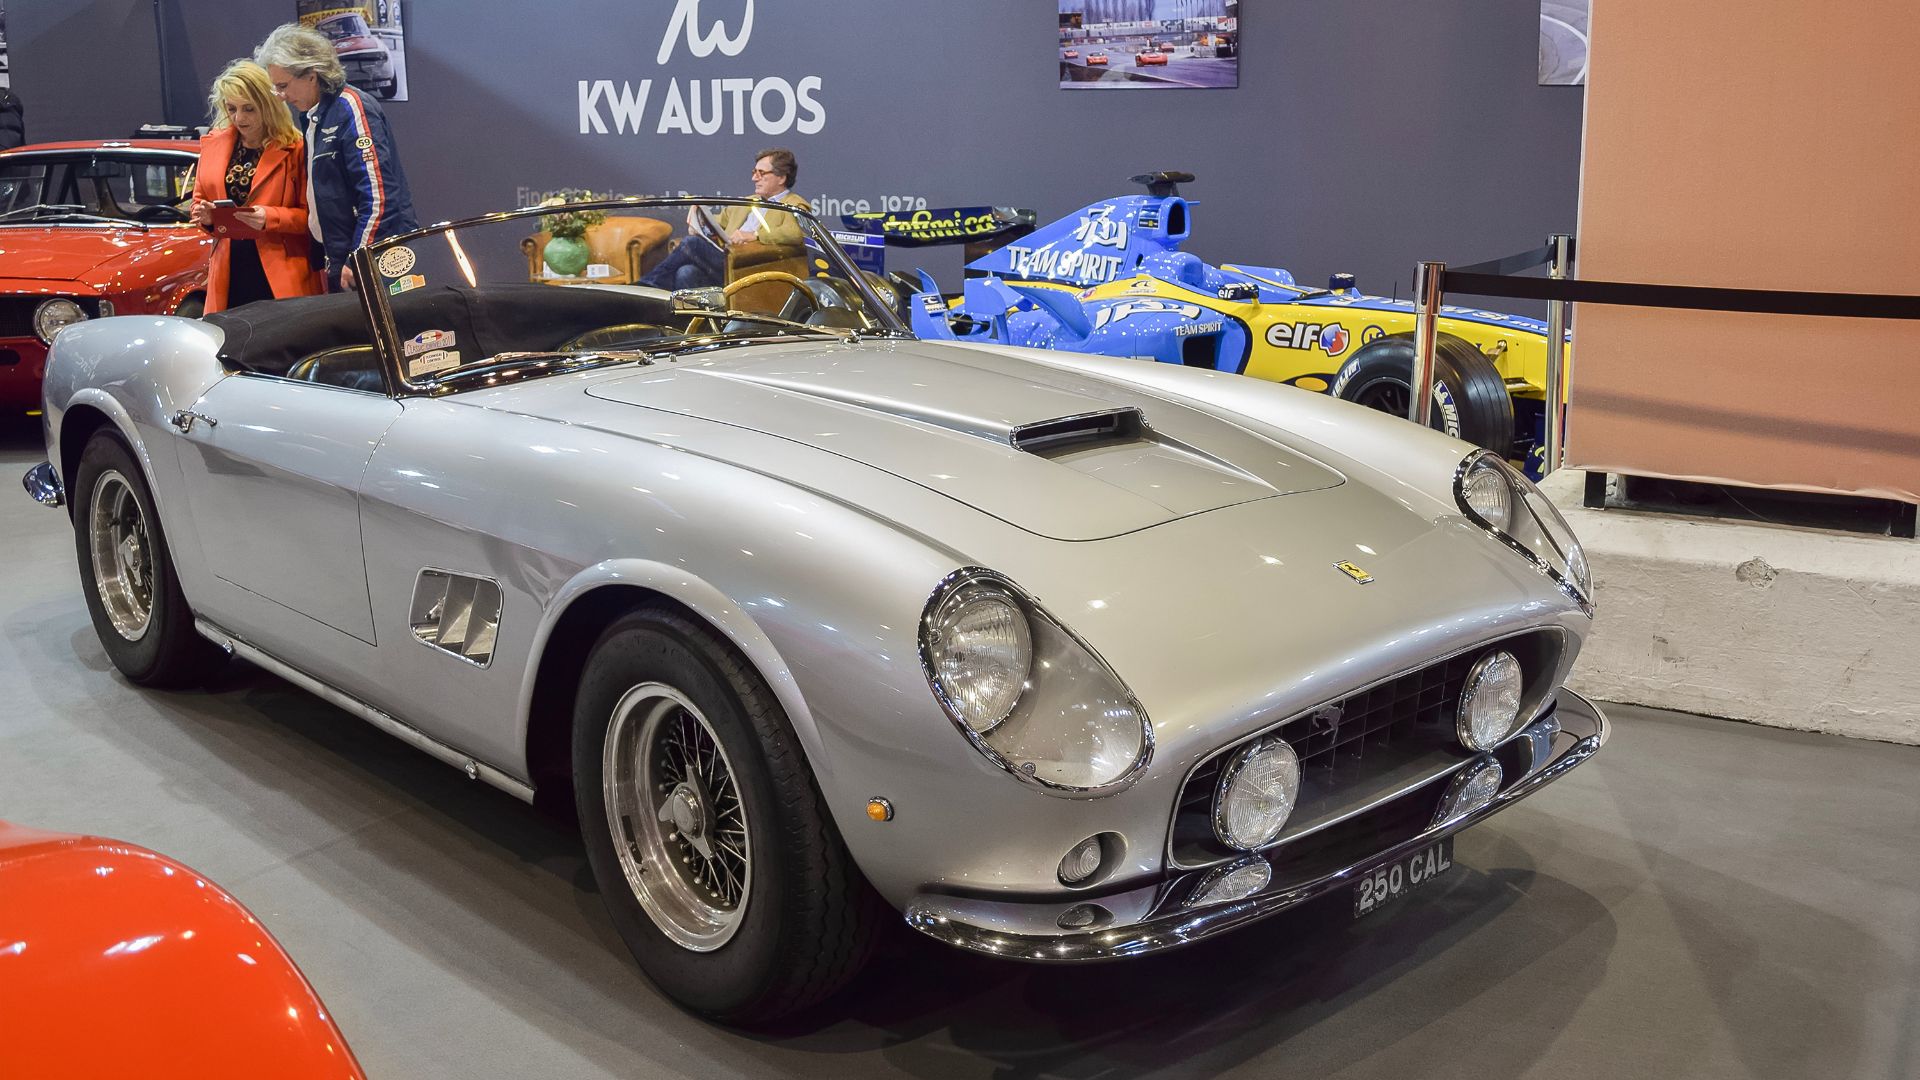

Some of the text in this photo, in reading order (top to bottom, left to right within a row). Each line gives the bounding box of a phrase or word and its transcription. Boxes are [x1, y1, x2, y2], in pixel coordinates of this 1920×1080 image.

[578, 76, 827, 136] KW AUTOS
[358, 139, 371, 147] 59
[810, 193, 871, 217] since
[880, 195, 928, 213] 1978
[835, 233, 865, 242] MICHELIN
[1006, 245, 1123, 283] TEAM SPIRIT
[1218, 289, 1235, 299] elf
[1174, 321, 1223, 337] TEAM SPIRIT
[1266, 322, 1321, 350] elf
[1360, 843, 1451, 911] 250 CAL
